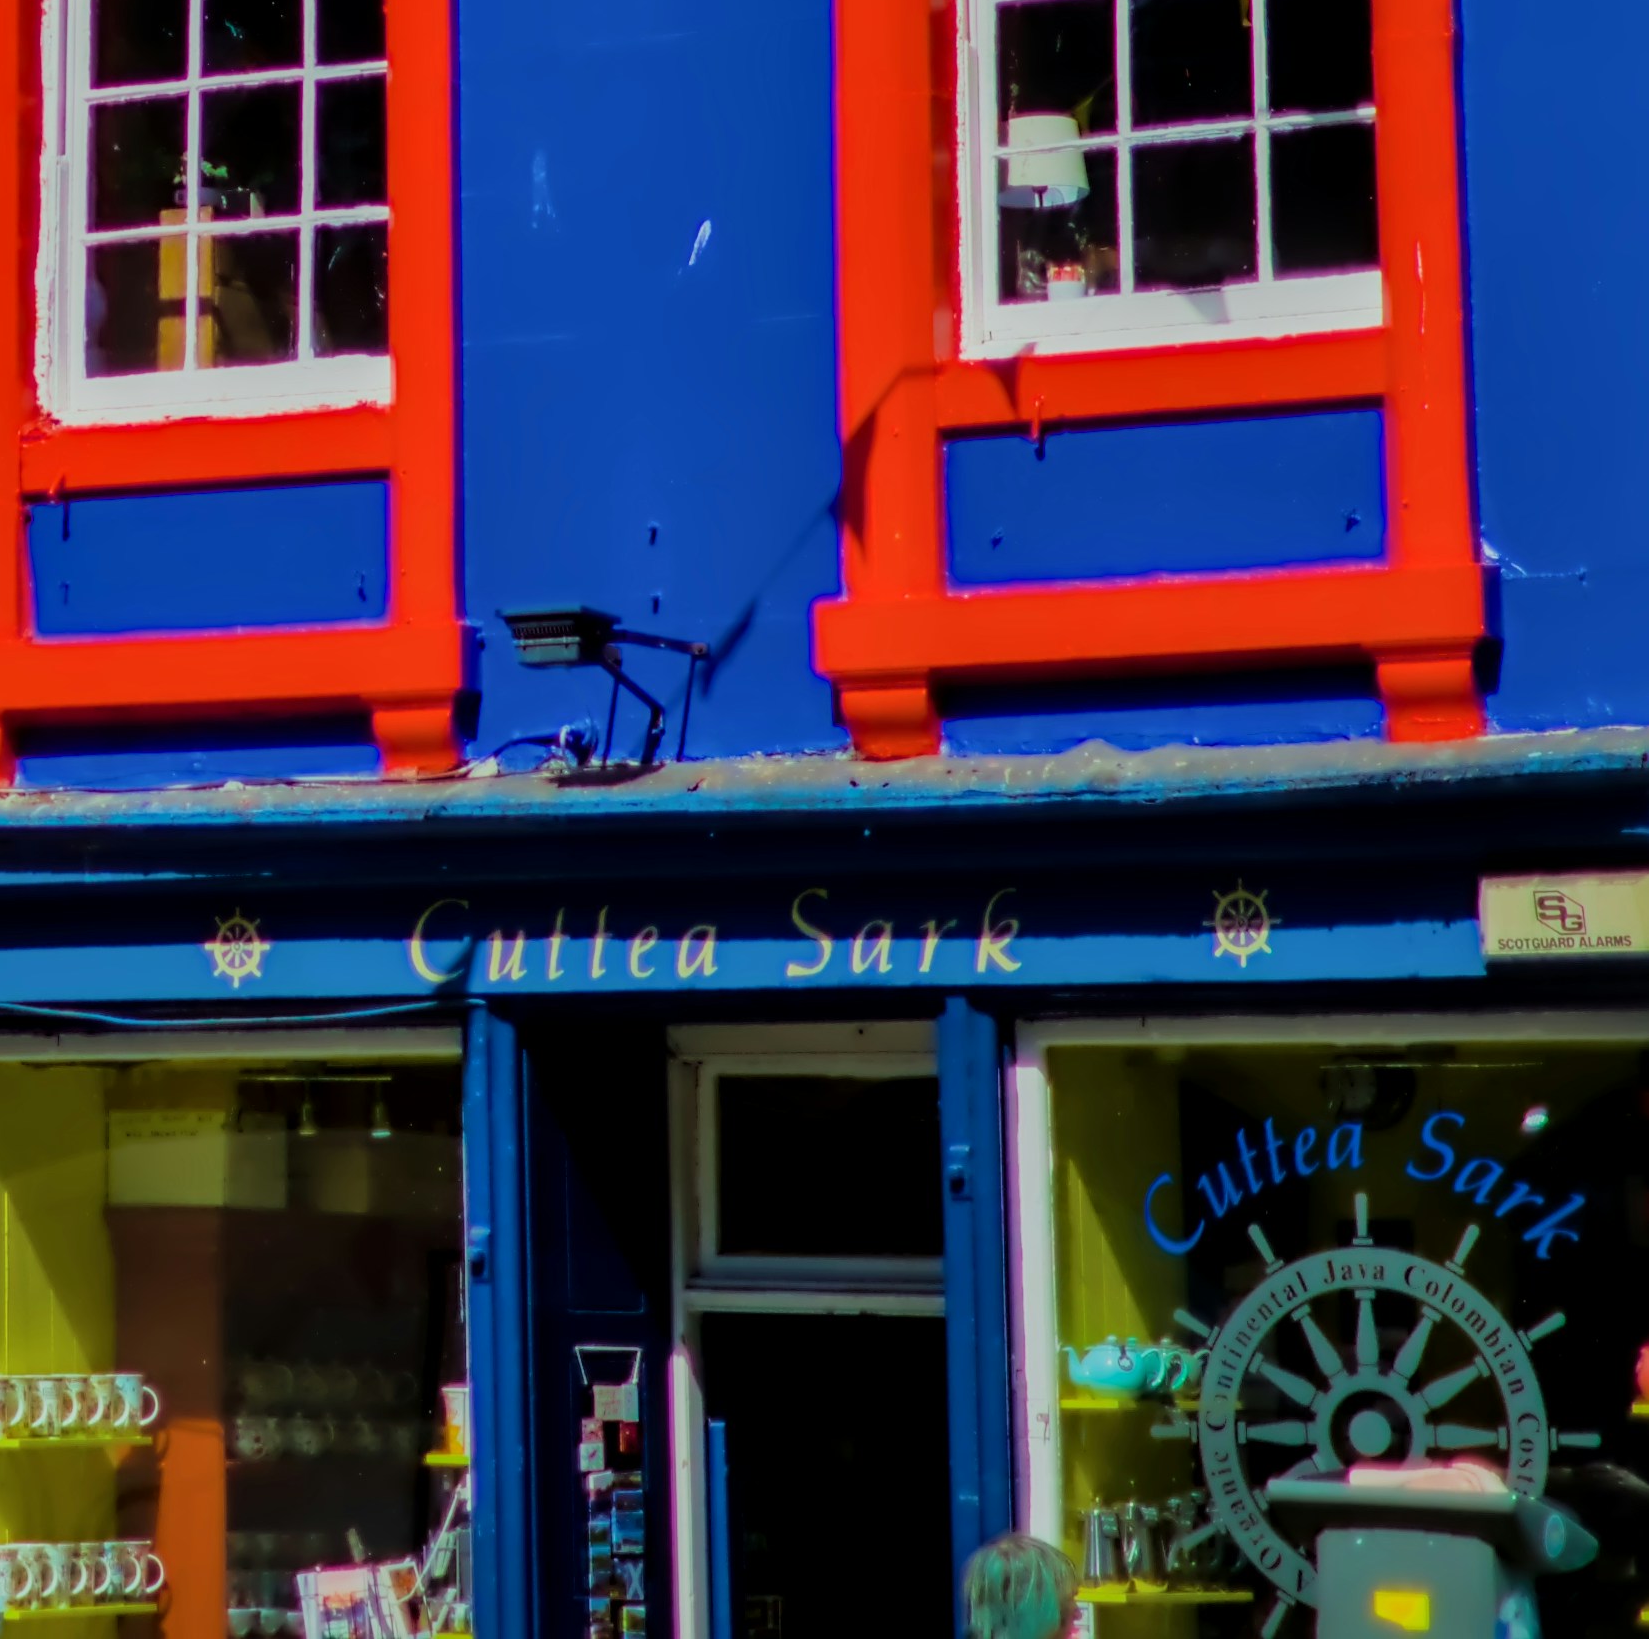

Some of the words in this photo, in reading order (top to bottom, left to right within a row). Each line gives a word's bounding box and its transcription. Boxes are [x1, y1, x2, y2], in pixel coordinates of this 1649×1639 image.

[409, 898, 719, 984] Cuttea
[786, 888, 1024, 976] Sark
[1498, 937, 1575, 950] SCOTGUARD
[1579, 935, 1632, 948] ALARMS
[1143, 1116, 1364, 1255] Cuttea
[1405, 1110, 1586, 1260] Sark
[1323, 1260, 1385, 1284] Java
[1404, 1265, 1528, 1395] Colombian
[1205, 1269, 1309, 1432] Continental
[1211, 1451, 1282, 1570] Organic
